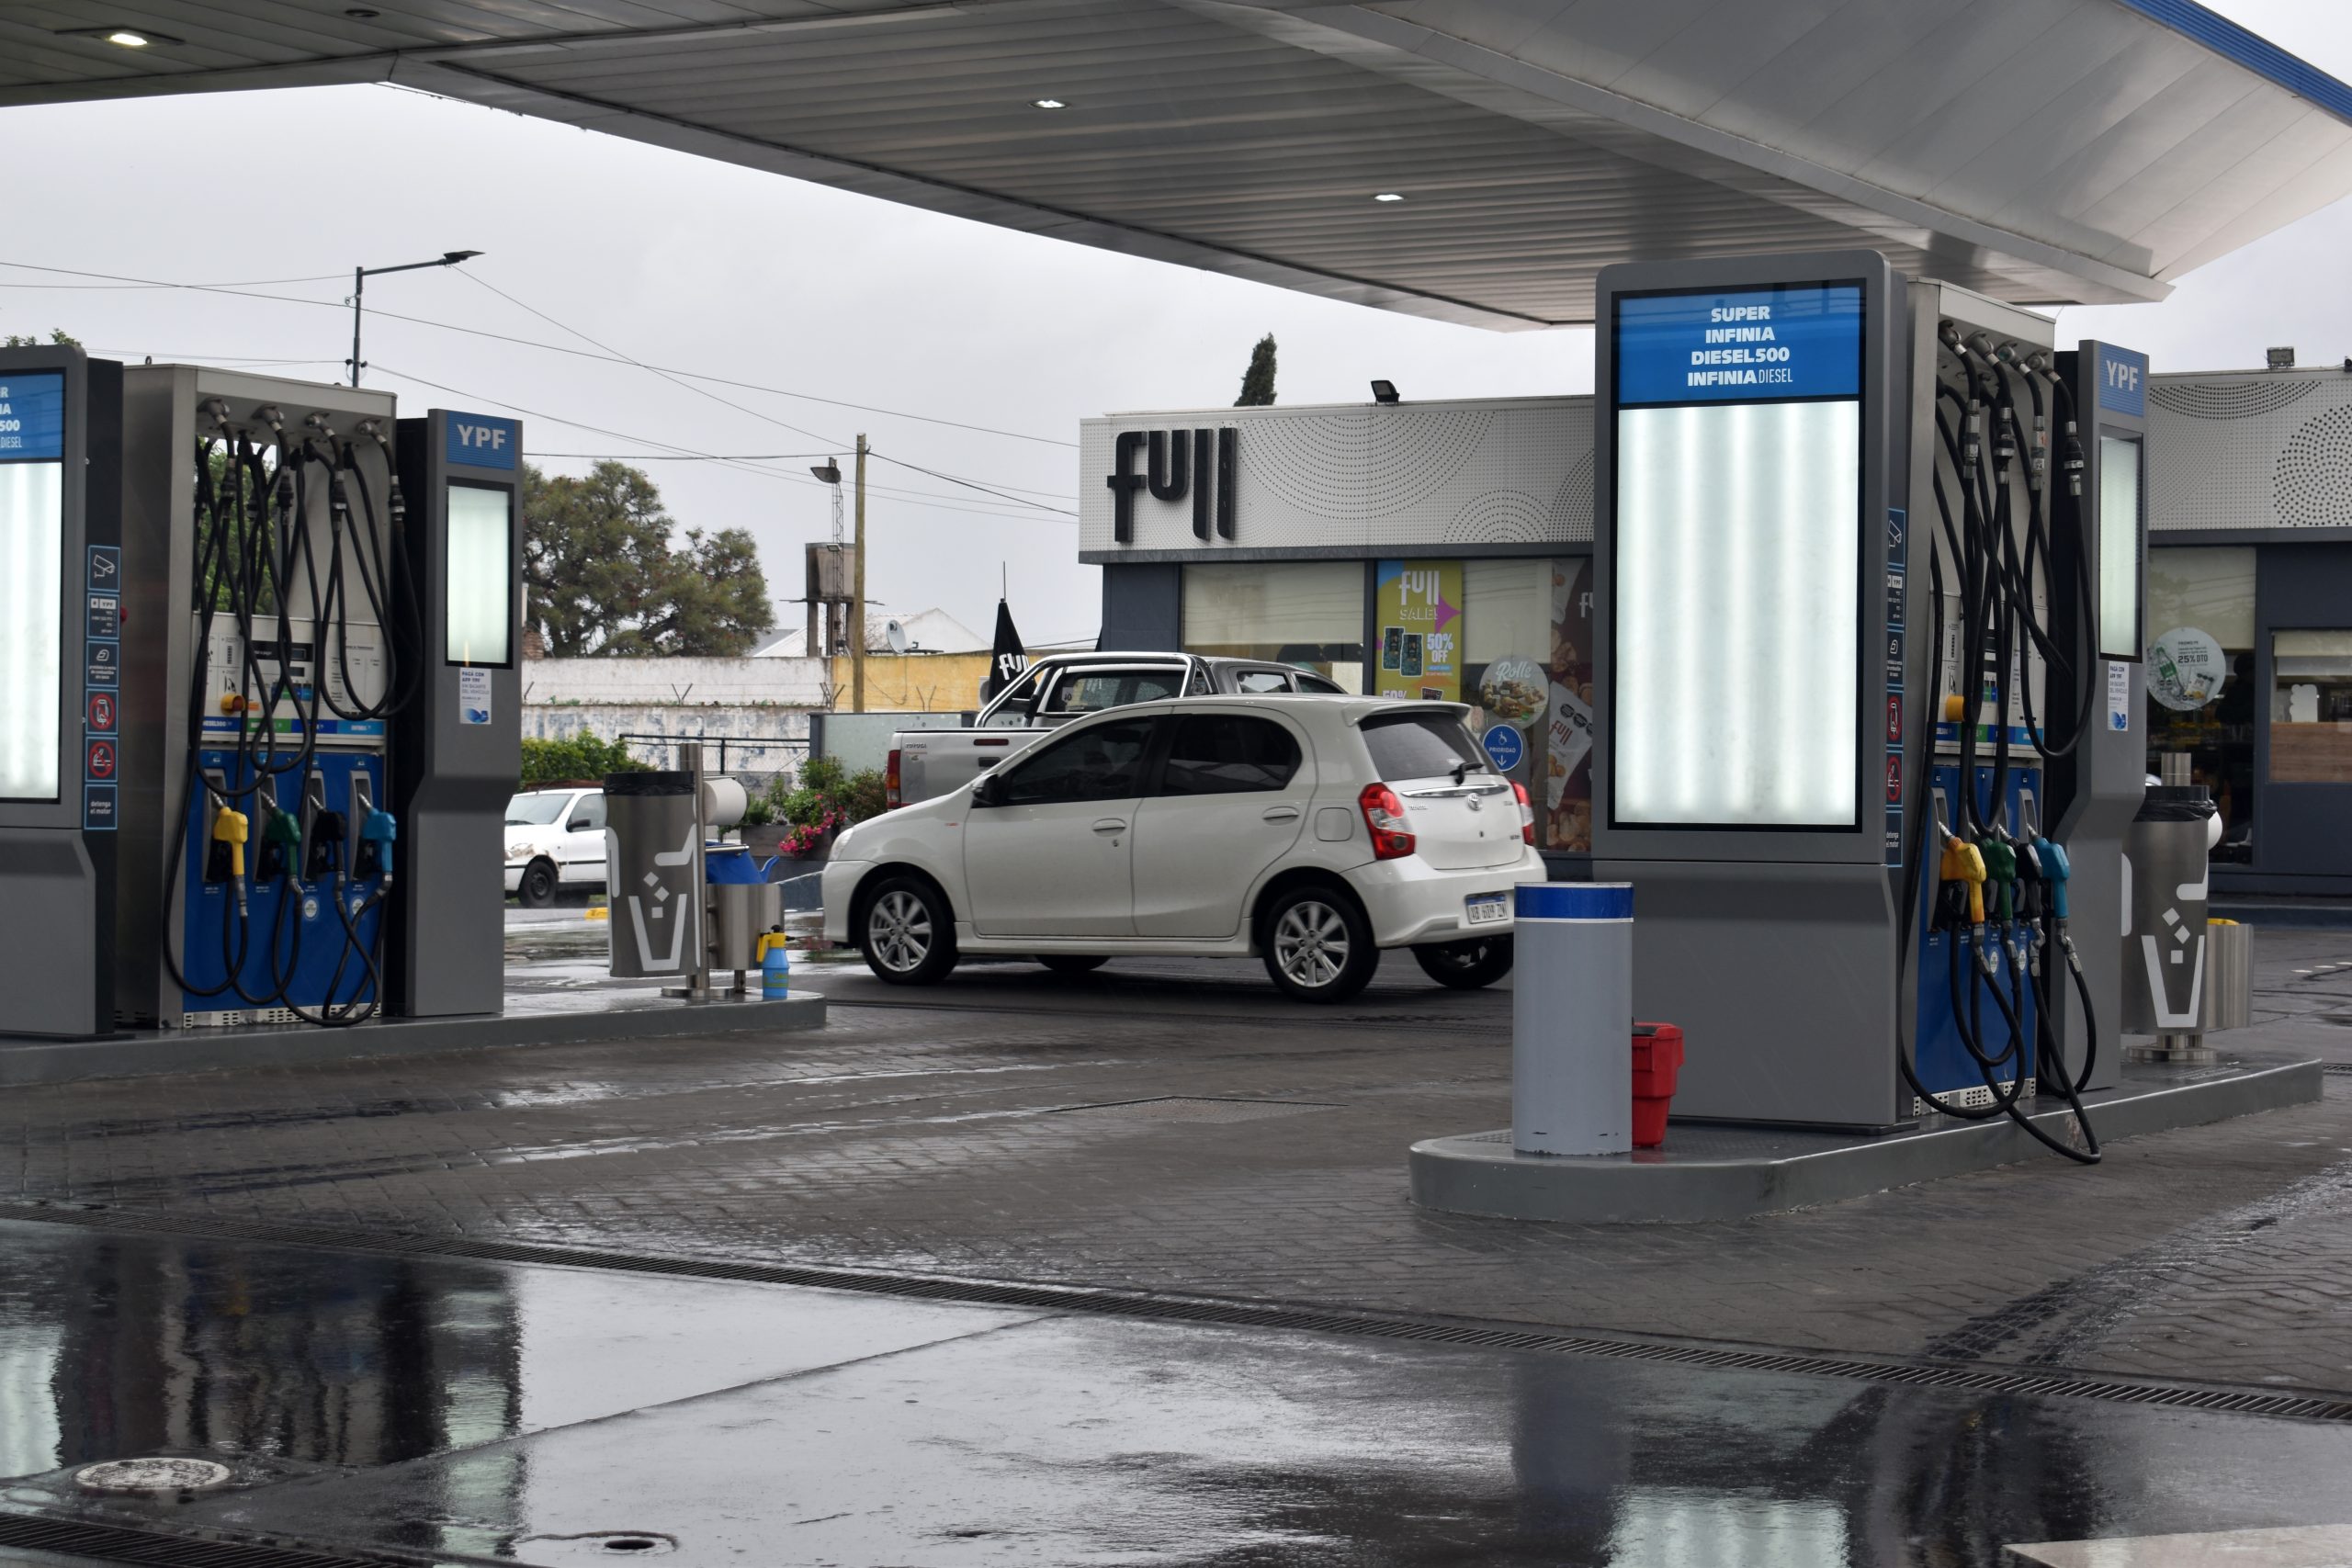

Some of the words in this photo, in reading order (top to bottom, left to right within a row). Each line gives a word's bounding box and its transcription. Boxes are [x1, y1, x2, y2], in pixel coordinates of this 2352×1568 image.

[1711, 306, 1770, 322] SUPER
[1705, 326, 1775, 344] INFINIA
[1691, 346, 1790, 365] DIESEL500
[2106, 359, 2139, 391] YPF
[457, 423, 506, 450] YPF
[1399, 607, 1439, 620] SALE!
[1427, 632, 1454, 650] 50%
[1431, 649, 1449, 663] OFF
[2178, 654, 2196, 663] 25%
[2197, 654, 2209, 662] DTO
